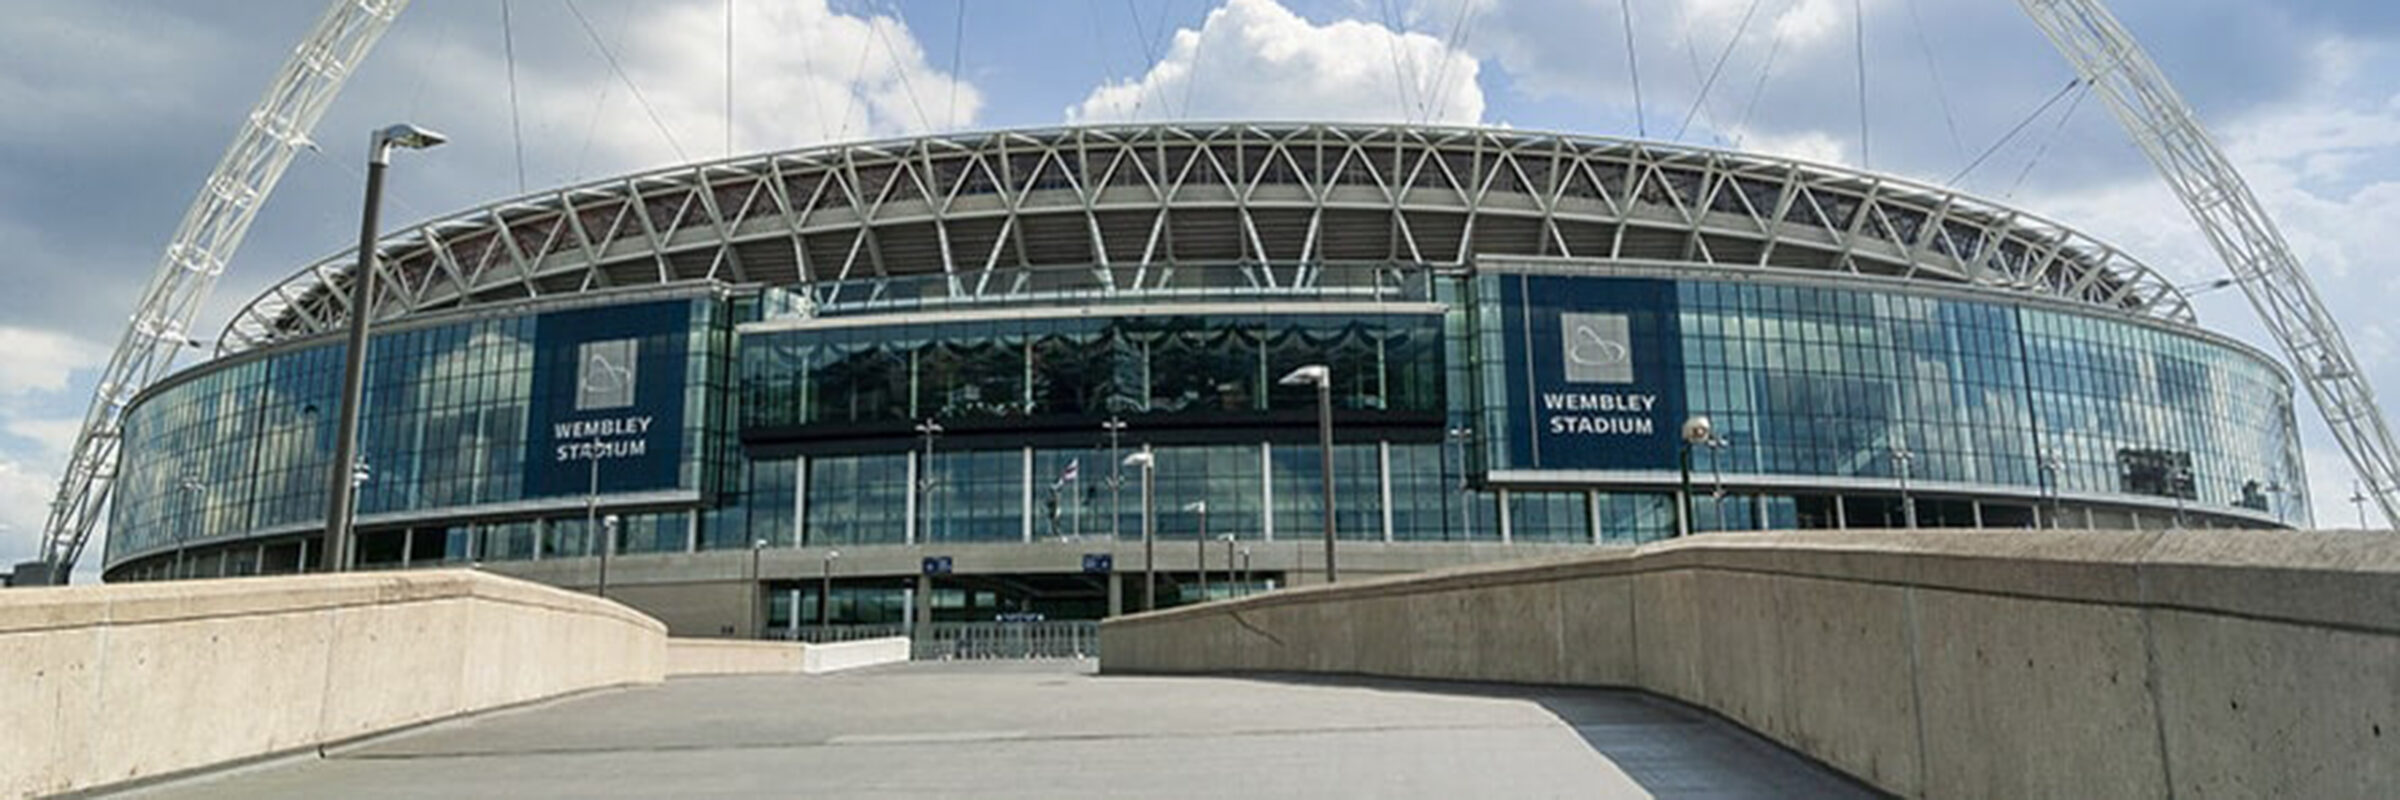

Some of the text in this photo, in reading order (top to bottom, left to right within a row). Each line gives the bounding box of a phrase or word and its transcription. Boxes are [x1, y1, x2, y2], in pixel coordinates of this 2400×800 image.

[1543, 393, 1656, 411] WEMBLEY
[555, 416, 652, 438] WEMBLEY
[1550, 416, 1654, 434] STADIUM
